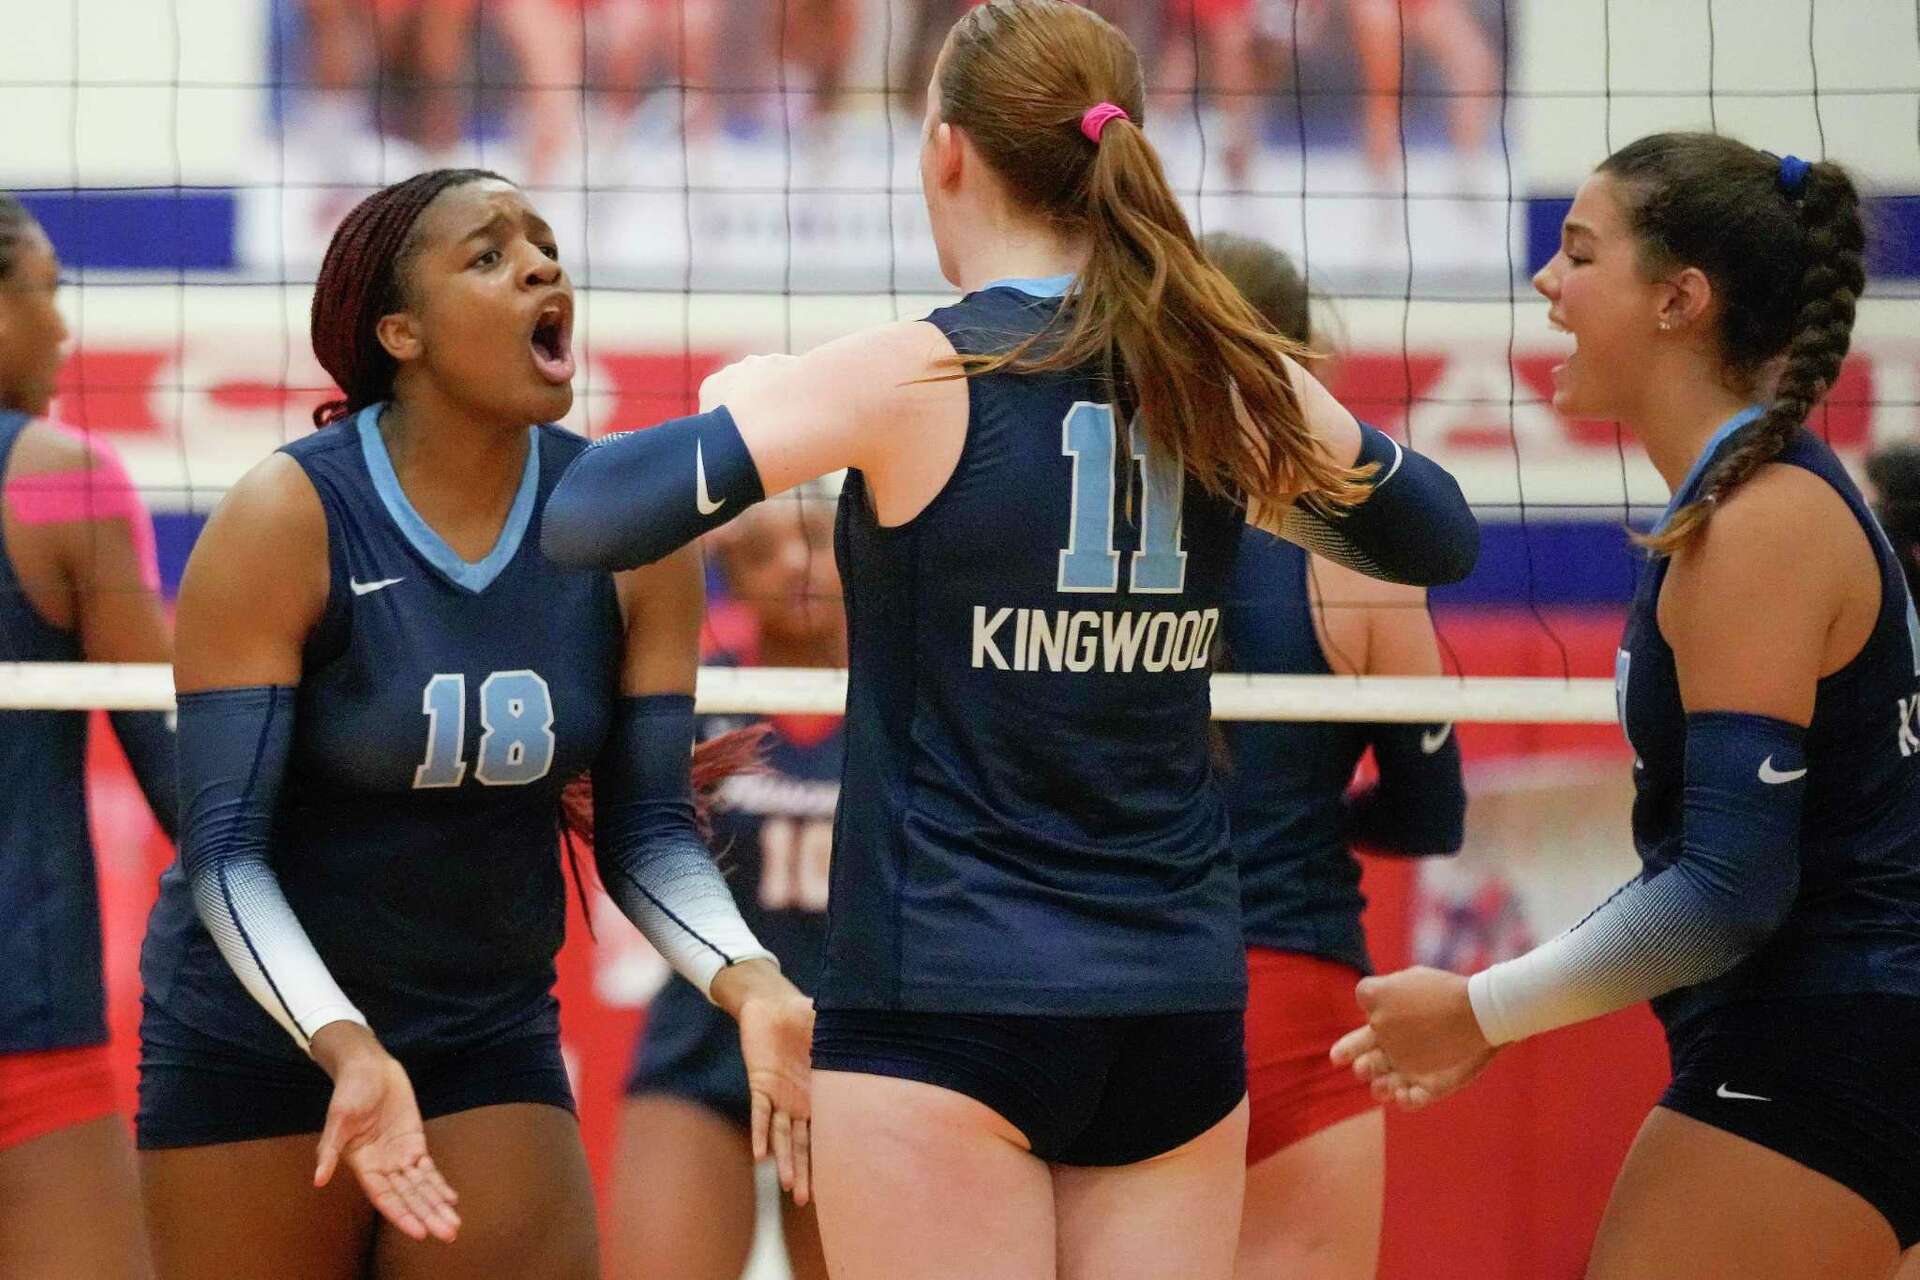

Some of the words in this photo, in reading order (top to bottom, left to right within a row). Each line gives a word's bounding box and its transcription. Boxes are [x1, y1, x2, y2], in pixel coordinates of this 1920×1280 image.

[1057, 401, 1188, 593] 11
[971, 606, 1219, 672] KINGWOOD
[412, 669, 556, 789] 18
